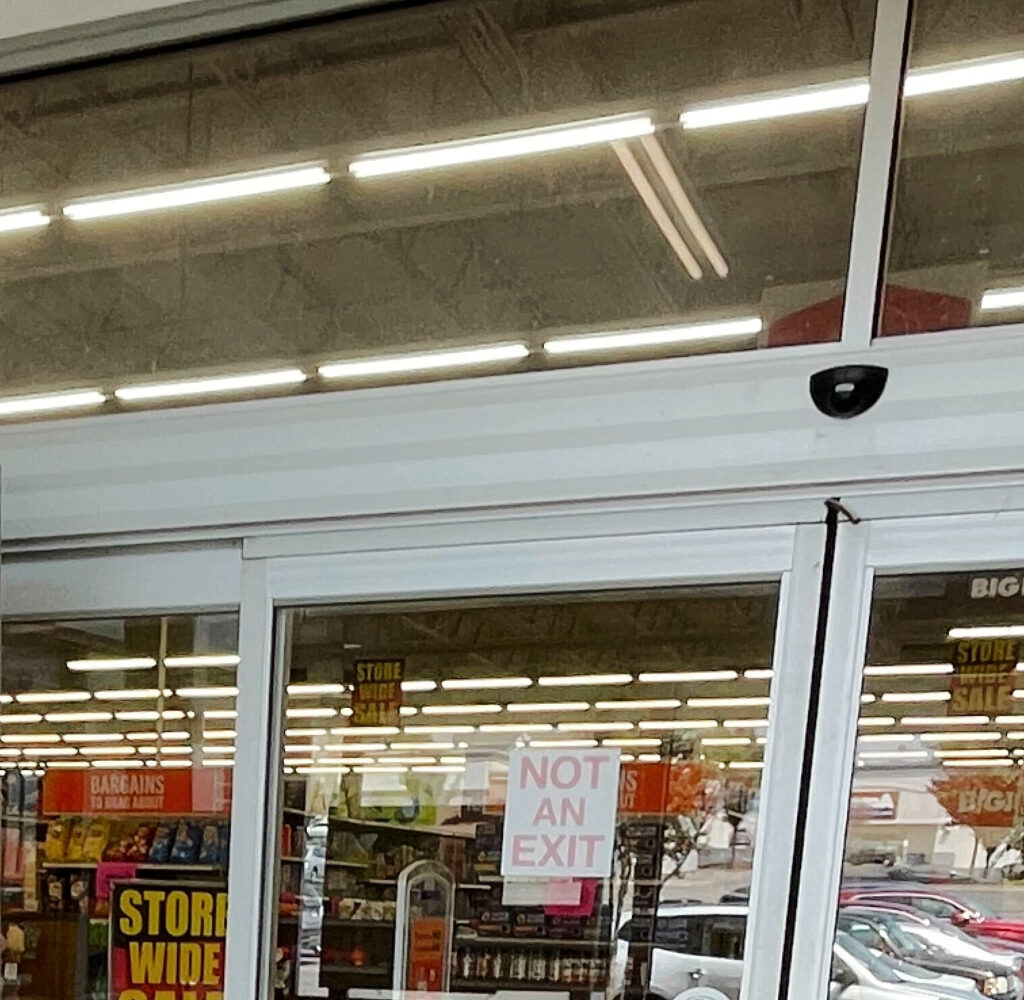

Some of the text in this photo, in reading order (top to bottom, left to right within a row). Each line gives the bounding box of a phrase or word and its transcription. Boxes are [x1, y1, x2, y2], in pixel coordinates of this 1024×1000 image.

[957, 640, 1017, 662] STORE
[357, 662, 401, 682] STORE
[952, 685, 1013, 712] SALE
[90, 774, 165, 794] BARGAINS
[520, 756, 610, 789] NOT
[532, 797, 586, 827] AN
[511, 834, 605, 868] EXIT
[128, 941, 221, 985] WIDE
